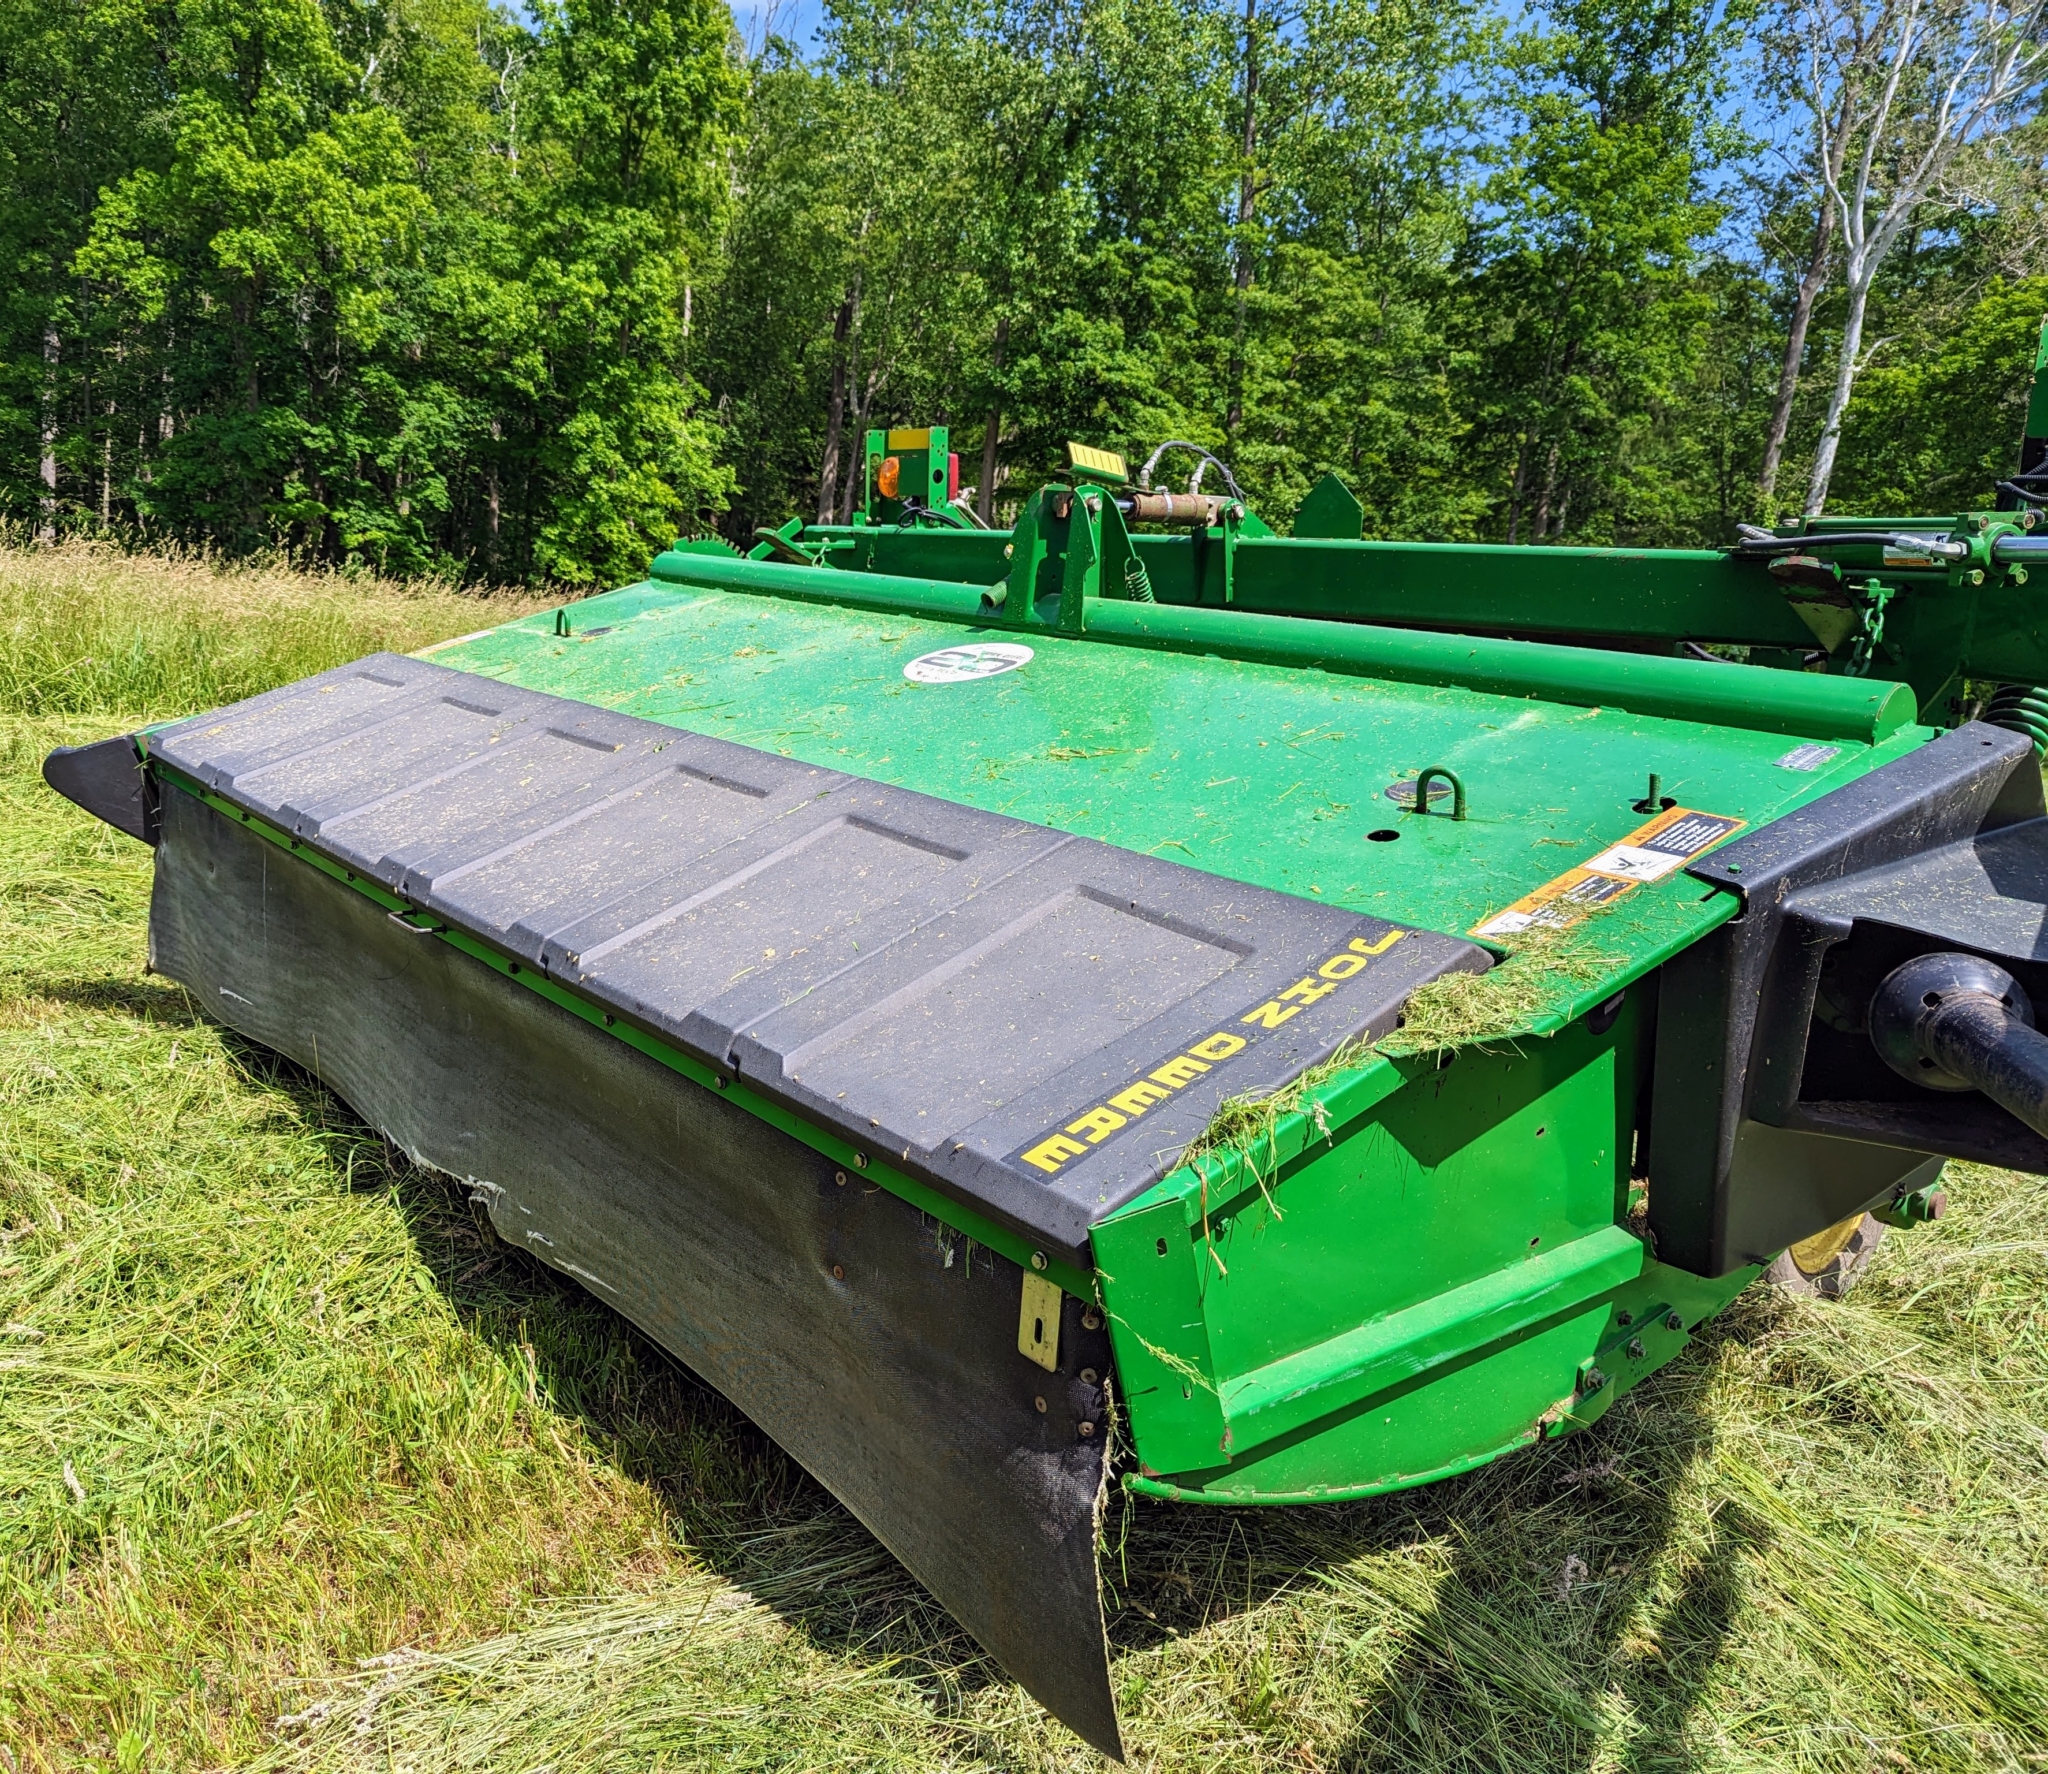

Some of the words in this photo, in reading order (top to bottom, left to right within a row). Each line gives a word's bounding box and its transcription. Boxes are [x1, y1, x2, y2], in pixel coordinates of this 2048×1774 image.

[1644, 814, 1678, 837] WARNING
[1240, 929, 1405, 1028] JOHN
[1020, 1032, 1247, 1173] DEERE
